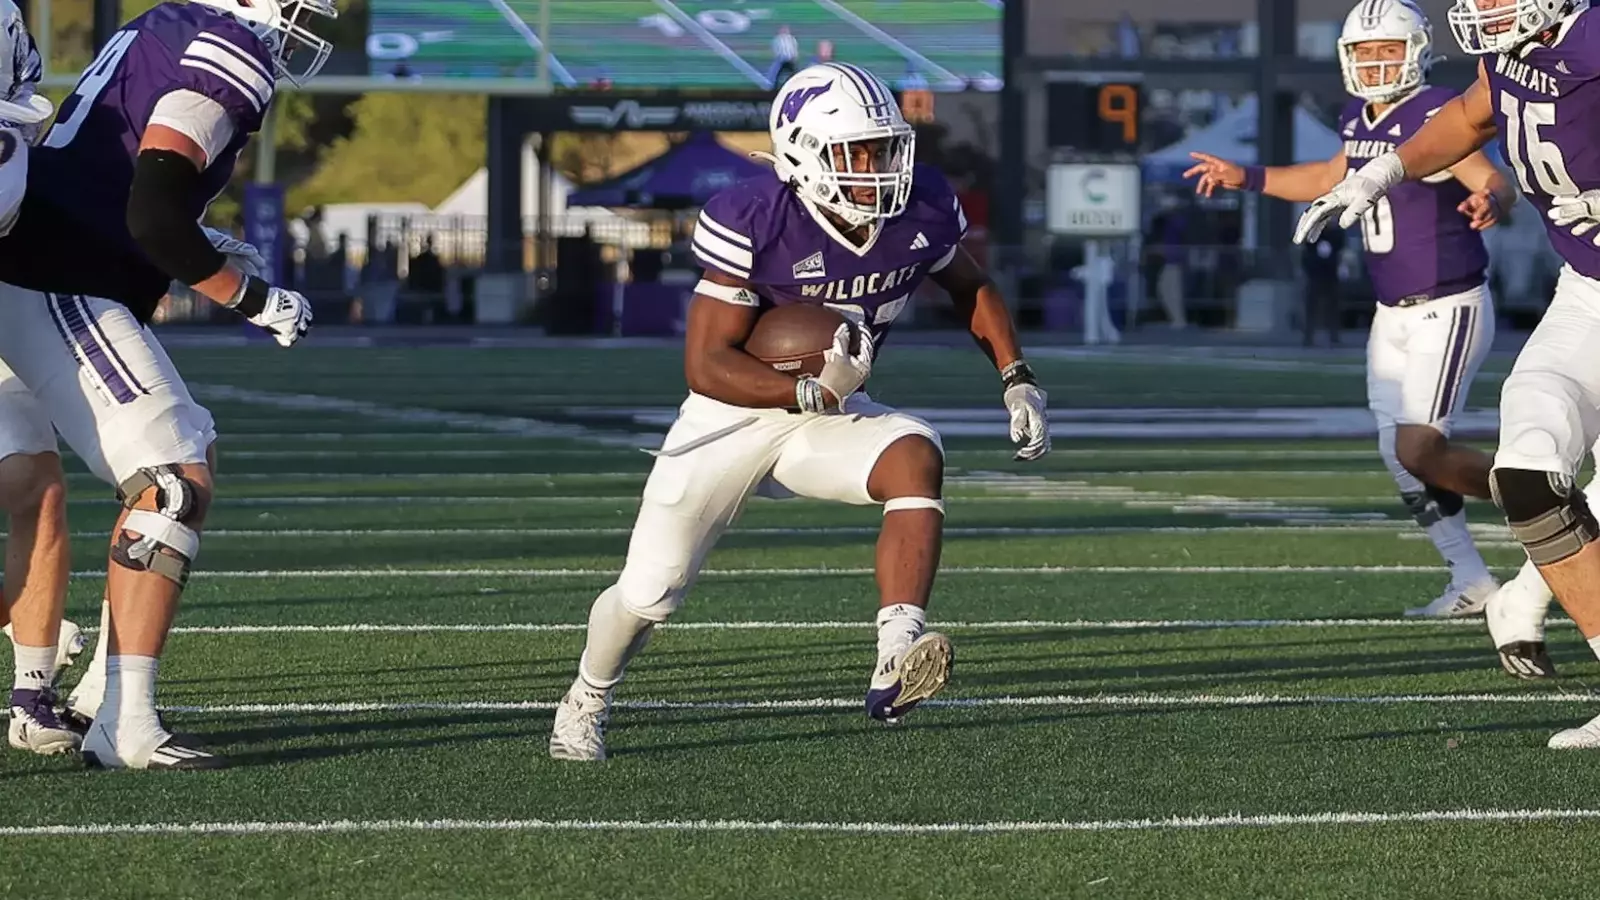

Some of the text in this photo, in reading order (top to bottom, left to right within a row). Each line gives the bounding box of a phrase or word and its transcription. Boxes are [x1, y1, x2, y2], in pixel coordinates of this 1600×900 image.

[42, 29, 140, 148] 9
[1495, 53, 1560, 97] WILDCATS
[1099, 84, 1138, 143] 9
[801, 262, 920, 300] WILDCATS
